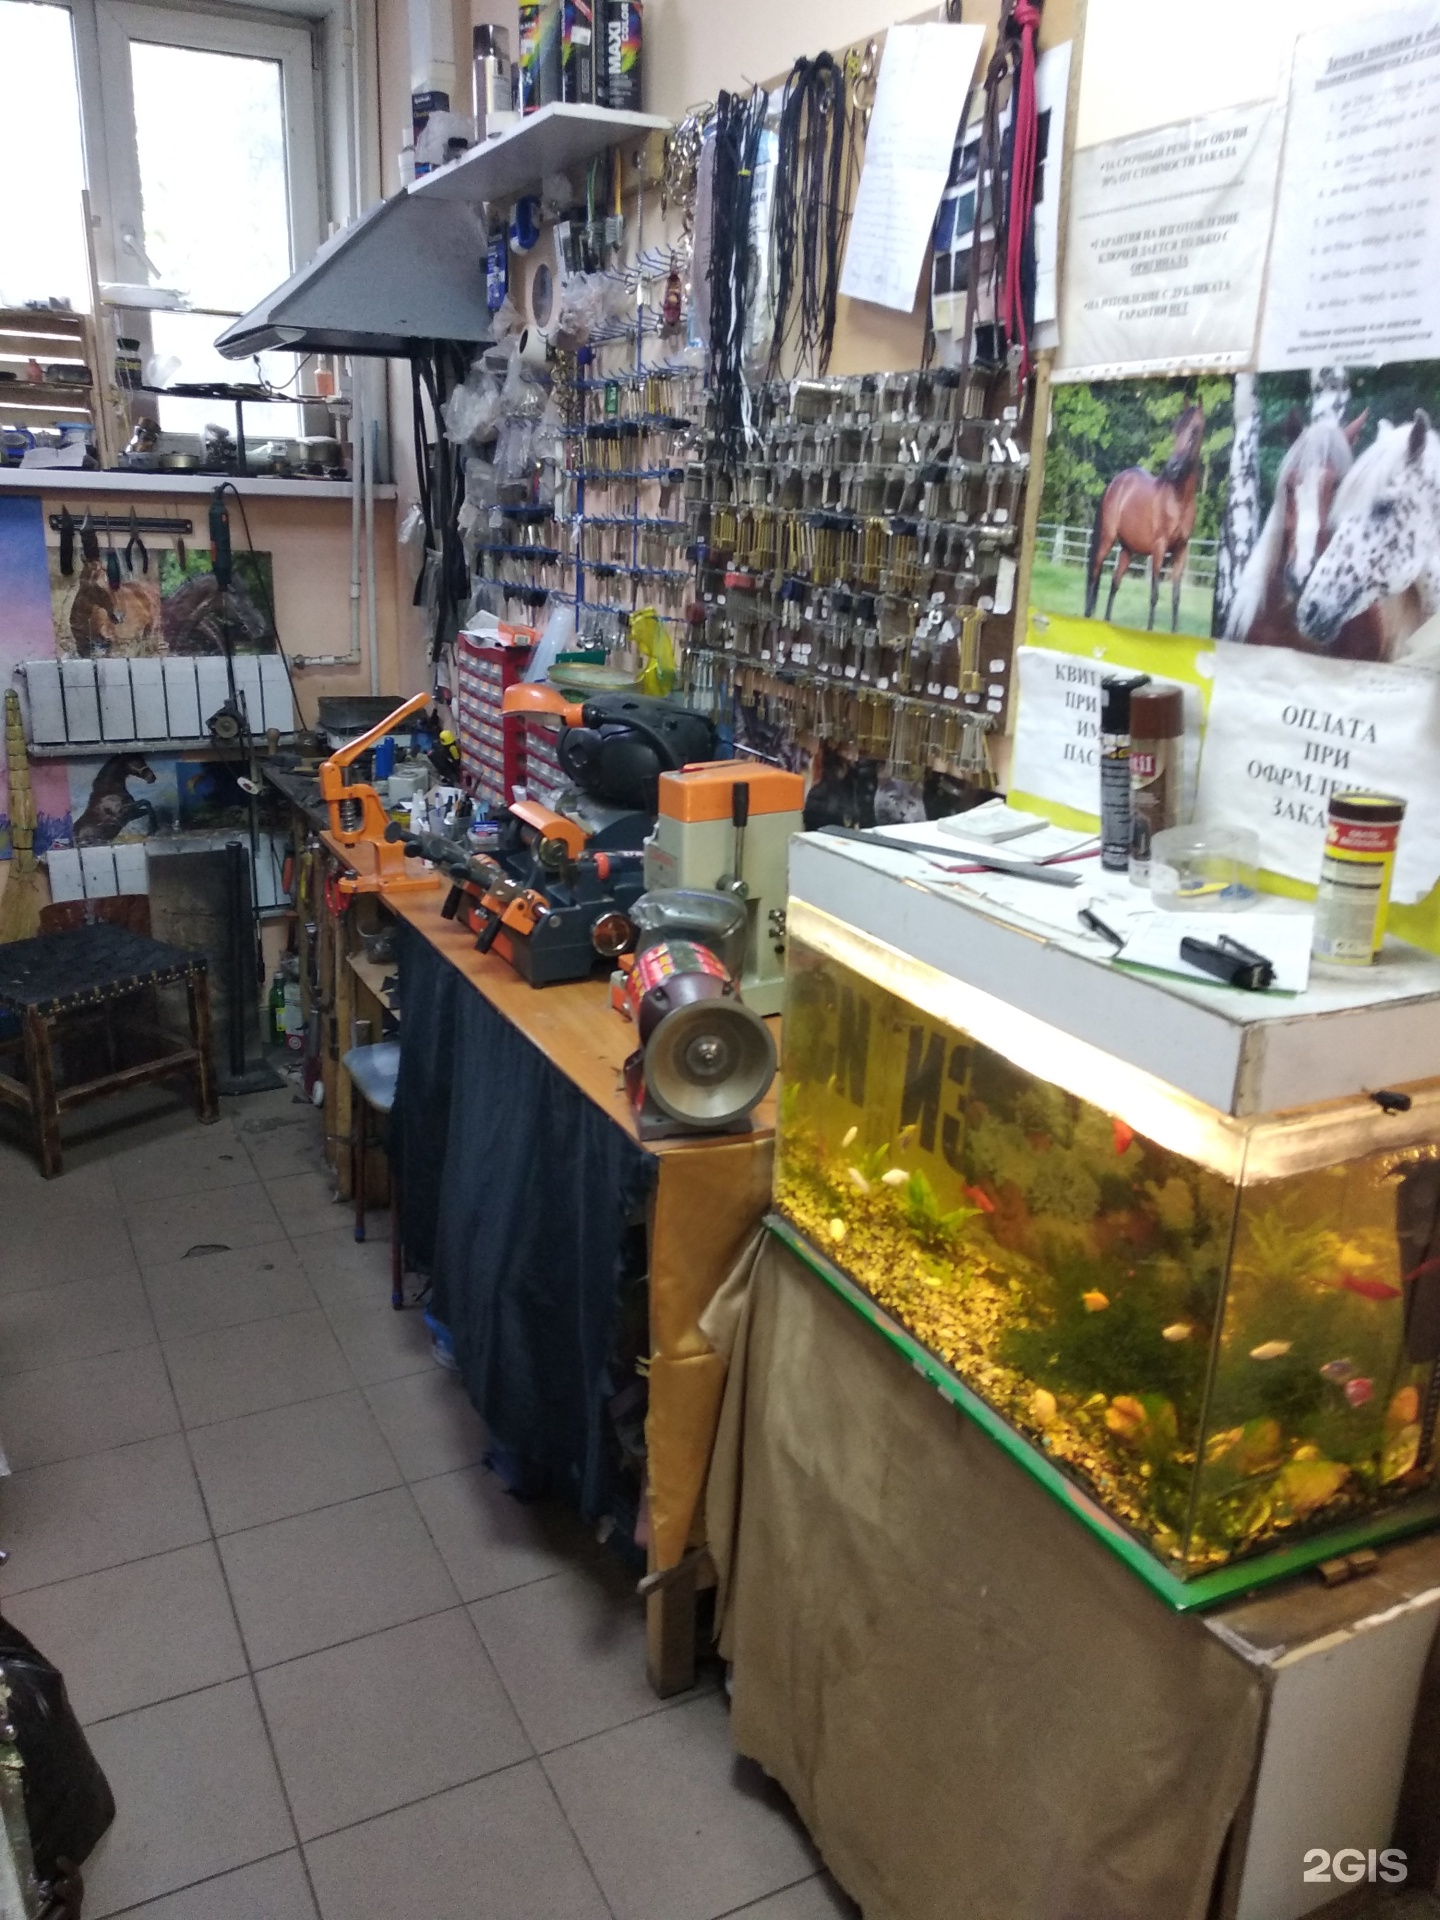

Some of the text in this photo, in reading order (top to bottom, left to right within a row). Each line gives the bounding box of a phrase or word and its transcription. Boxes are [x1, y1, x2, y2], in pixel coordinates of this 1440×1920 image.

[609, 21, 621, 74] MAXI
[1166, 139, 1208, 156] РЕМНТ
[1199, 146, 1238, 164] ЗАКАЗА
[1093, 230, 1142, 249] ГАРАНТИЯ
[1158, 211, 1240, 238] ИЗГОТОВЛЕНИЕ
[1056, 664, 1098, 687] КВИТ
[1282, 705, 1377, 744] ОПЛАТА
[1064, 743, 1100, 767] ПАС
[1304, 741, 1350, 770] ПРИ
[1247, 759, 1372, 797] ОФРМЛЕ
[1273, 797, 1326, 830] ЗАКА
